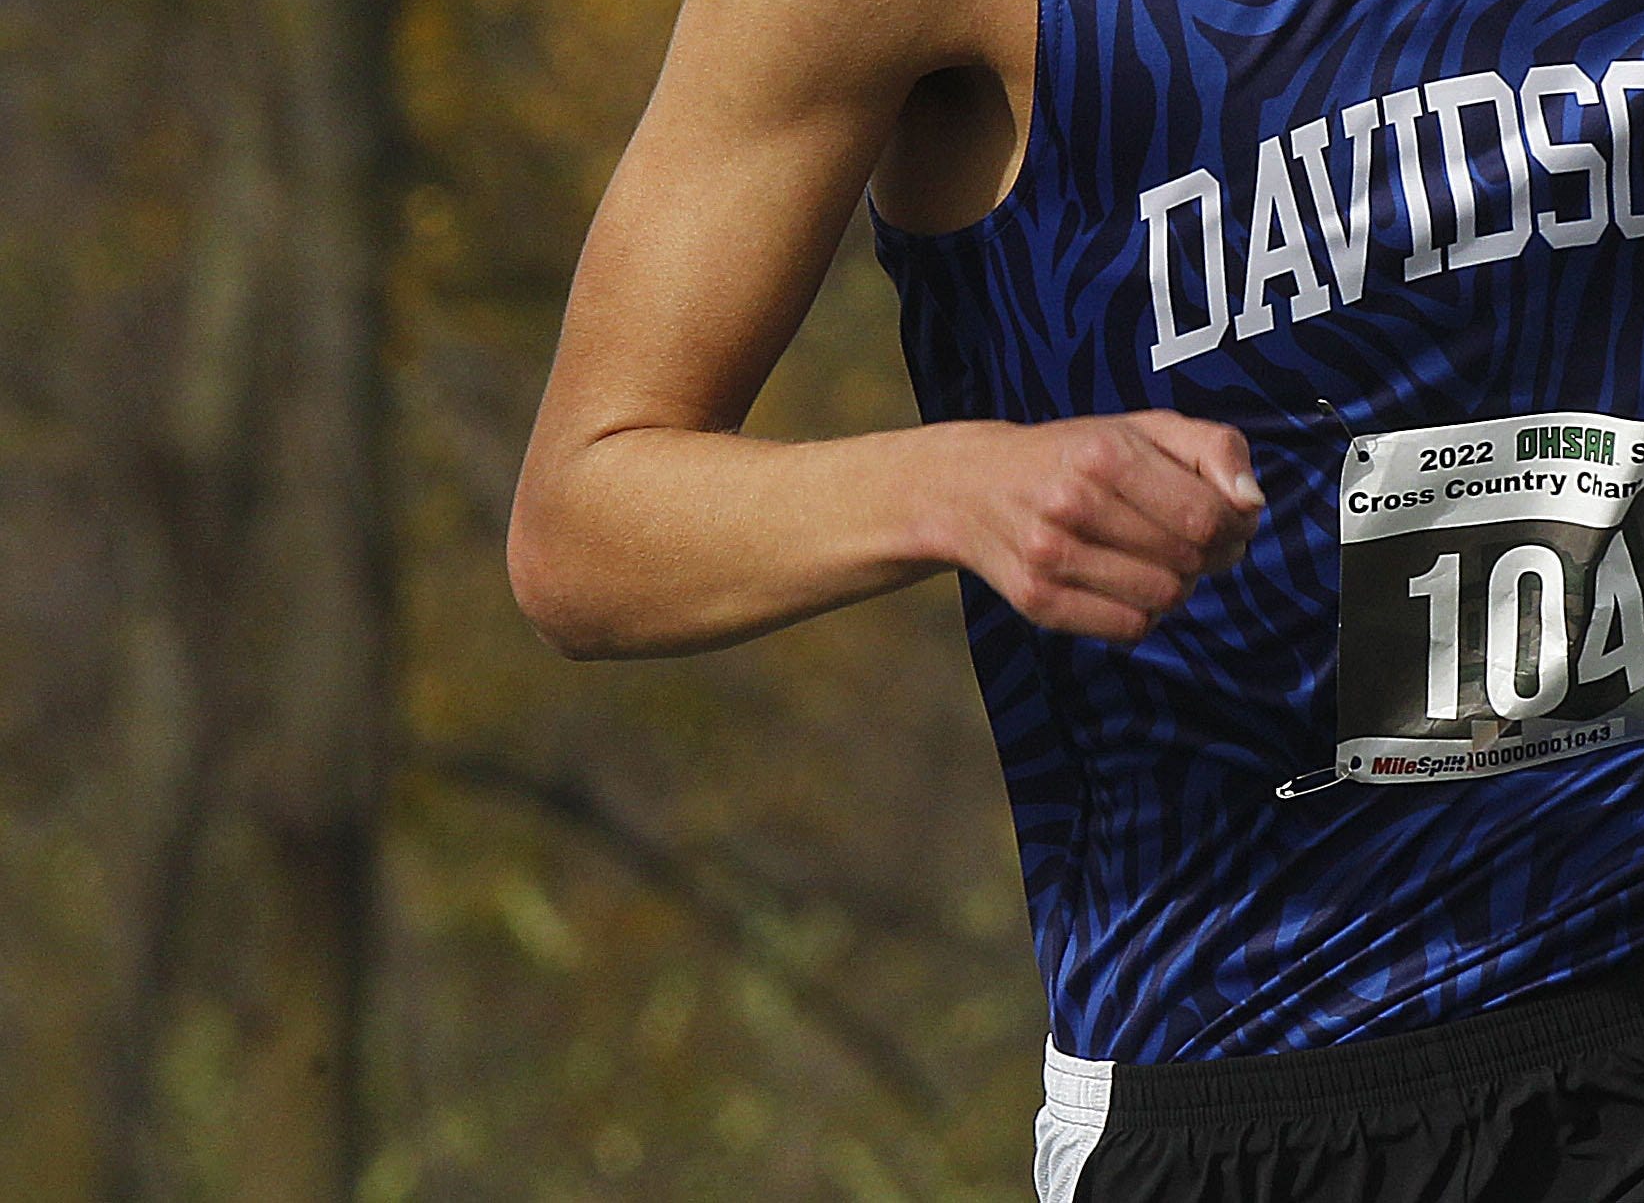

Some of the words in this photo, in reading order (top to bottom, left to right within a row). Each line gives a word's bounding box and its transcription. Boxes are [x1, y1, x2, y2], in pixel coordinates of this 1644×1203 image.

[1419, 441, 1494, 472] 2022
[1516, 426, 1616, 466] OHSAA
[1348, 487, 1435, 514] Cross
[1445, 470, 1567, 500] Country
